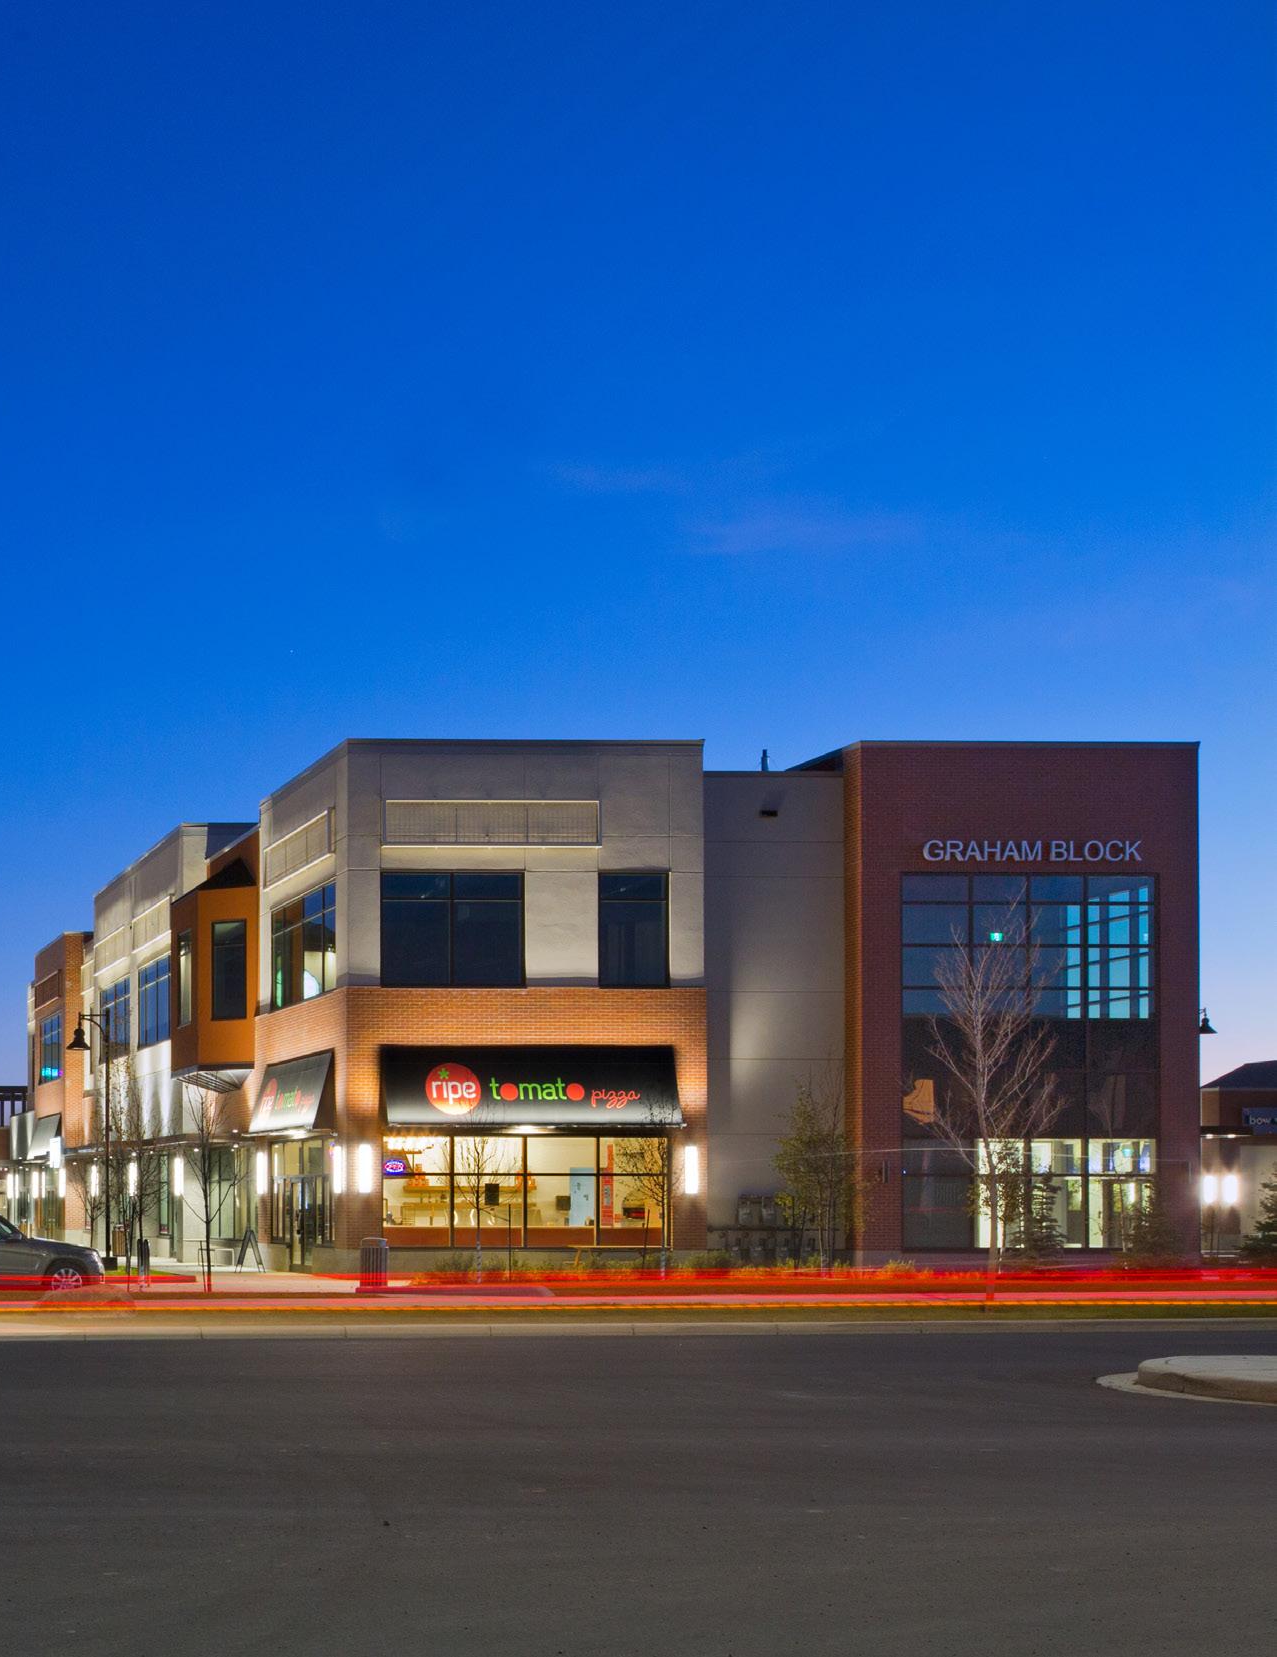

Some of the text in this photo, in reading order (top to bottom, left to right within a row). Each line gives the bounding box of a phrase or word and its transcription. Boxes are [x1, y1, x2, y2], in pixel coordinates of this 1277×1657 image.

[922, 839, 1143, 862] GRAHAM BLOCK
[431, 1077, 641, 1109] ripe tomato pizza
